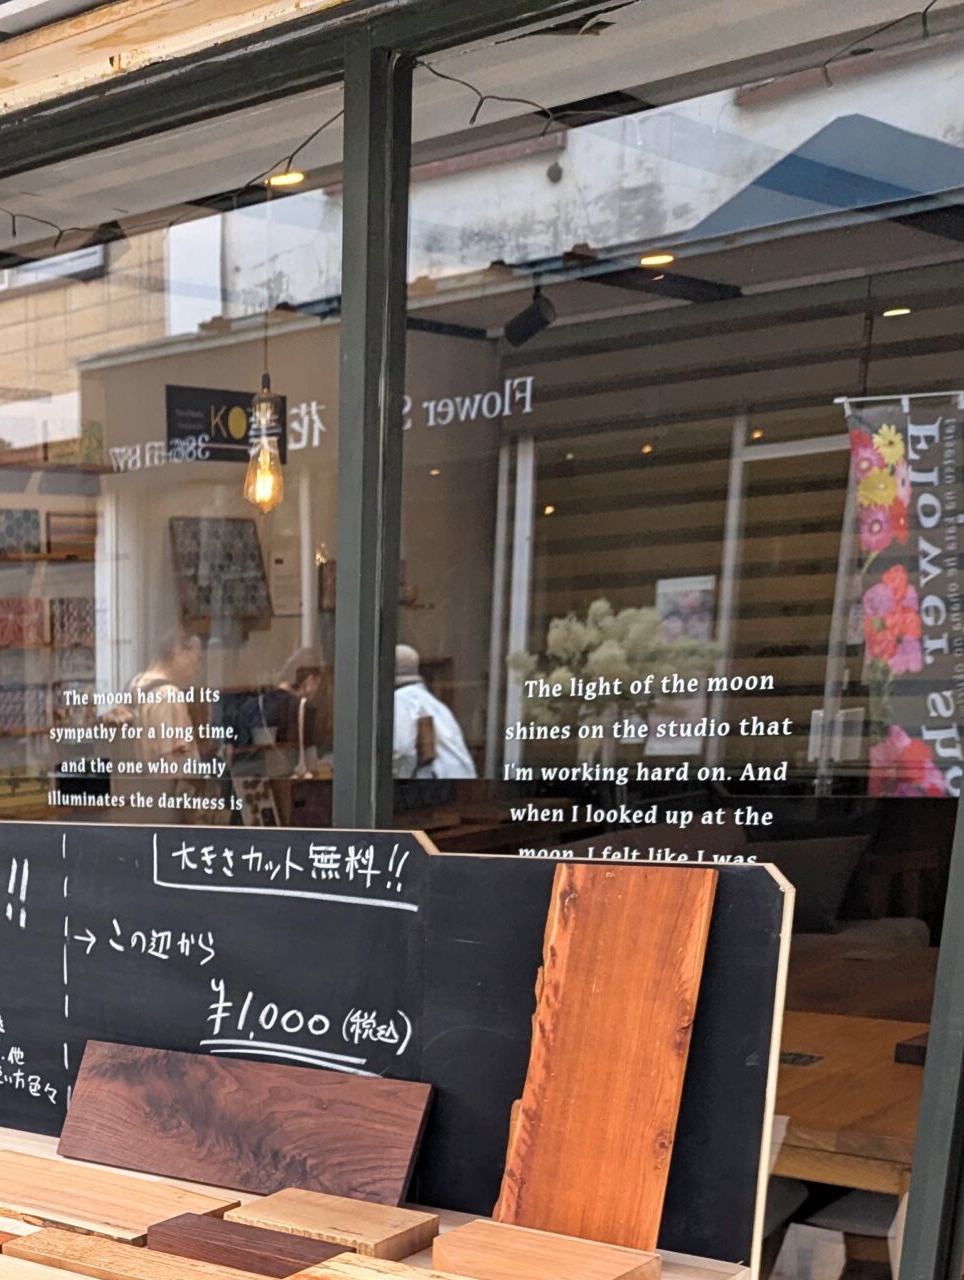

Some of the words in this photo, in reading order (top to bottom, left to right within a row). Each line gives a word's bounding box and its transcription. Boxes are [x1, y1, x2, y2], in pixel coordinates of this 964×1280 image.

[63, 690, 89, 706] The
[93, 691, 132, 705] moon
[137, 688, 163, 704] has
[167, 686, 195, 704] had
[199, 687, 221, 703] its
[524, 679, 563, 699] The
[569, 676, 623, 701] light
[629, 674, 656, 695] of
[661, 672, 699, 694] the
[706, 674, 775, 693] moon
[49, 724, 117, 743] sympathy
[121, 724, 143, 740] for
[147, 728, 156, 740] a
[161, 723, 194, 742] long
[198, 724, 239, 741] time,
[505, 721, 571, 740] shines
[577, 723, 605, 739] on
[612, 720, 649, 738] the
[656, 718, 731, 738] studio
[738, 716, 794, 736] that
[60, 758, 86, 774] and
[90, 757, 113, 774] the
[117, 760, 143, 774] one
[147, 758, 179, 774] who
[182, 758, 227, 778] dimly
[503, 763, 533, 781] I'm
[540, 762, 629, 785] working
[636, 762, 690, 782] hard
[697, 767, 733, 782] on.
[738, 761, 788, 782] And
[47, 790, 126, 807] illuminates
[130, 791, 154, 808] the
[158, 792, 226, 810] darkness
[230, 795, 243, 811] is
[509, 804, 565, 823] when
[571, 805, 579, 823] I
[585, 804, 658, 825] looked
[665, 809, 694, 830] up
[700, 807, 726, 825] at
[733, 806, 774, 826] the
[171, 841, 410, 893] 大きさカット無料!!
[108, 918, 216, 965] この辺から
